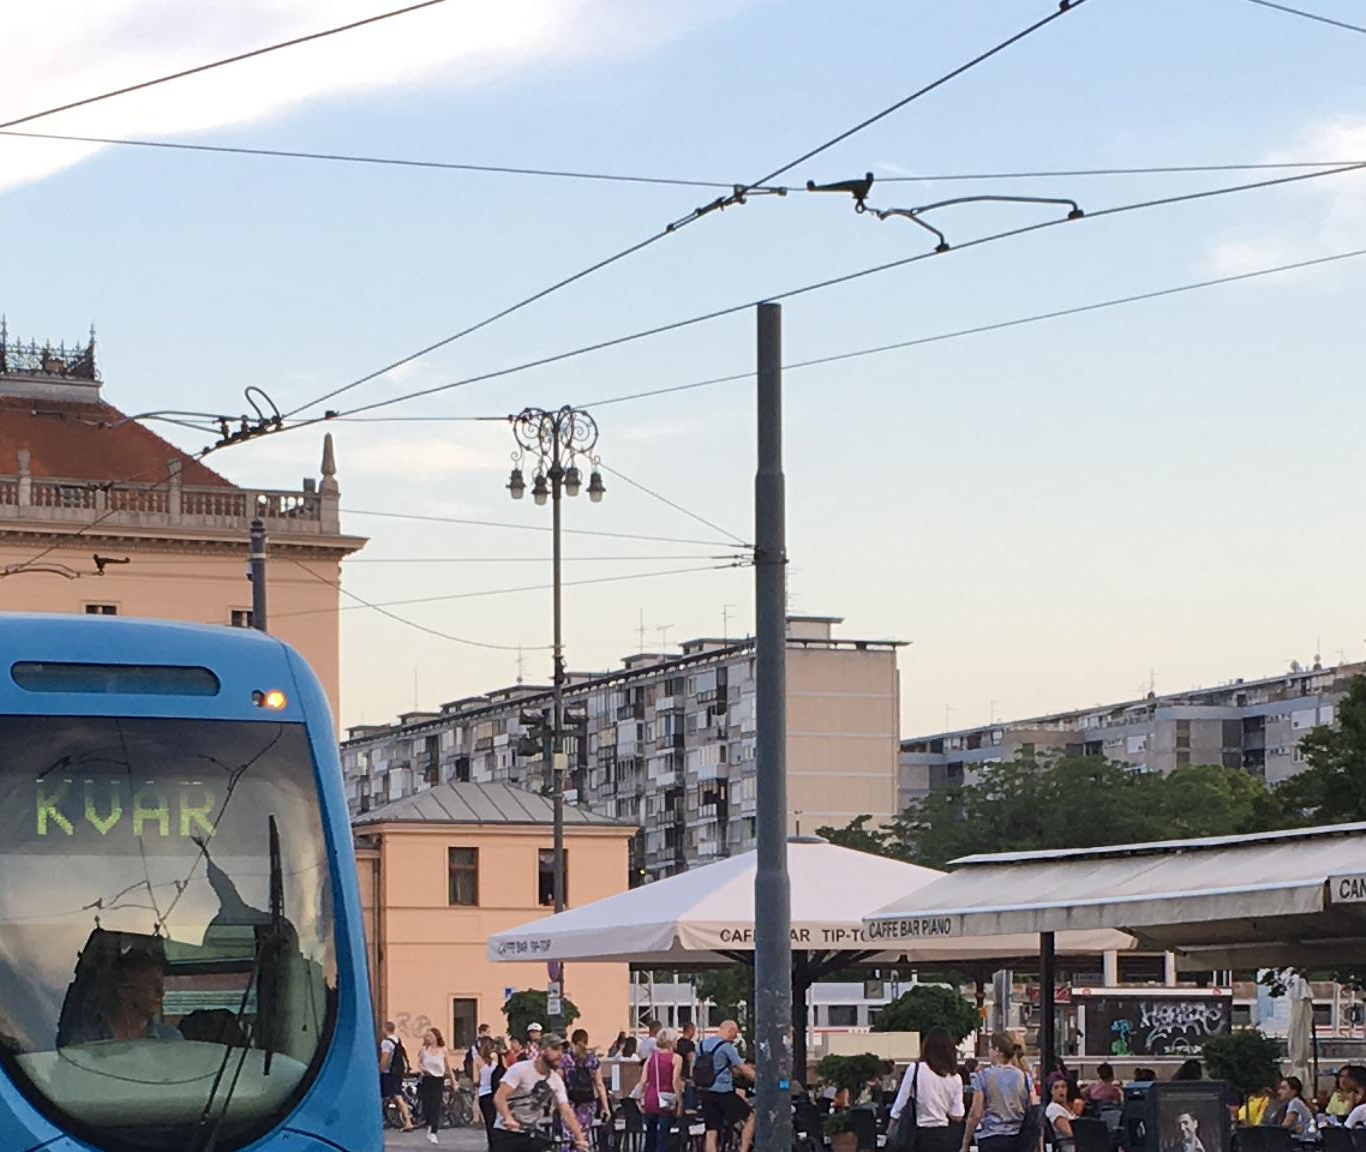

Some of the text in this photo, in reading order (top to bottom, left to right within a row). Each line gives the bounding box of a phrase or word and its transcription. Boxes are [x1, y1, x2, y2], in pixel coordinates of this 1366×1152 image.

[36, 779, 217, 836] KVAR
[719, 929, 864, 943] CAF AR TIP-T
[869, 918, 952, 939] CAFFE BAR PIANO
